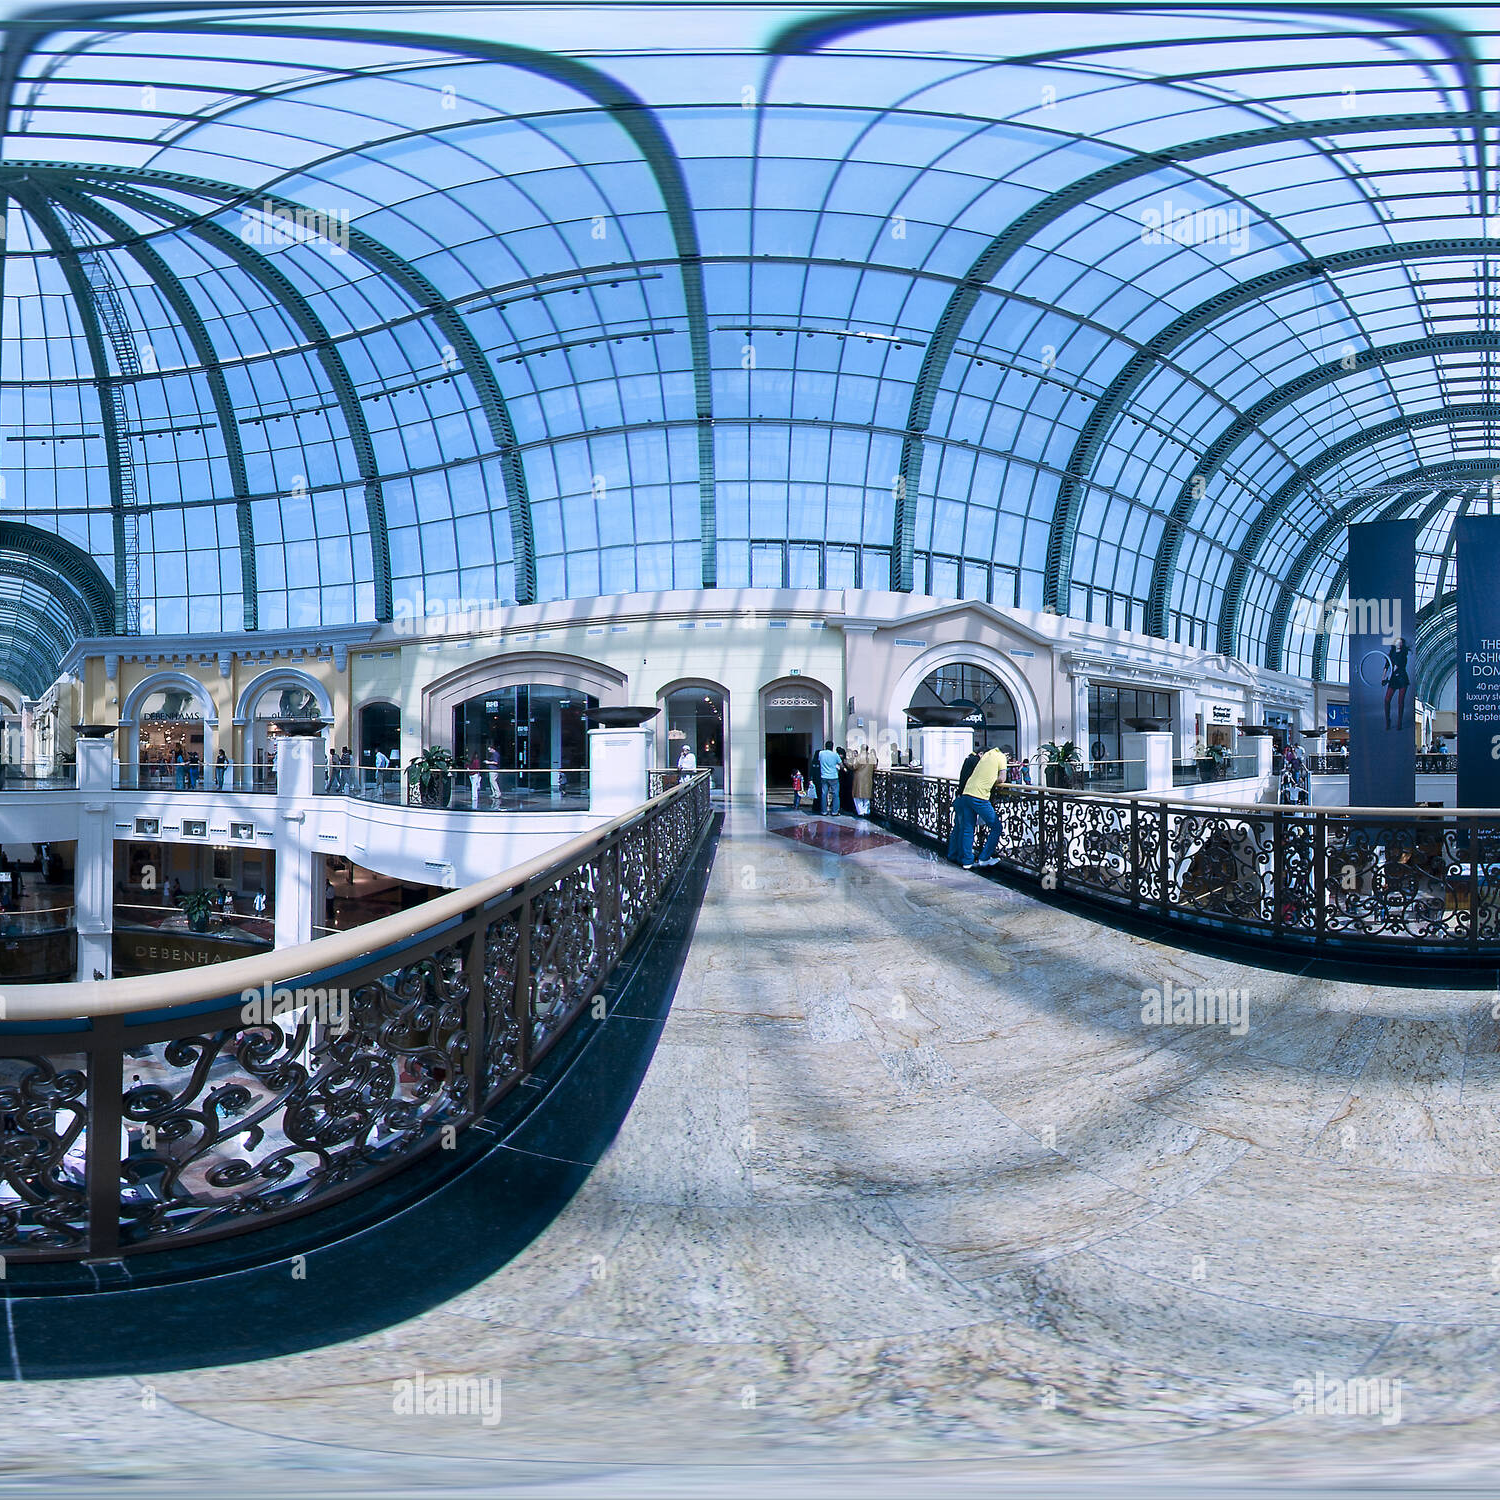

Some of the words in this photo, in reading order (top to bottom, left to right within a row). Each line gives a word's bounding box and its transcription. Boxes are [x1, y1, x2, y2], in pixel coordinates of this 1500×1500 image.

[1465, 652, 1500, 663] FASHI
[1472, 666, 1500, 676] DOM
[1466, 692, 1491, 701] luxury
[144, 712, 200, 720] DEBENHAMS
[1474, 713, 1500, 722] Septe
[135, 946, 222, 963] DEBENHA
